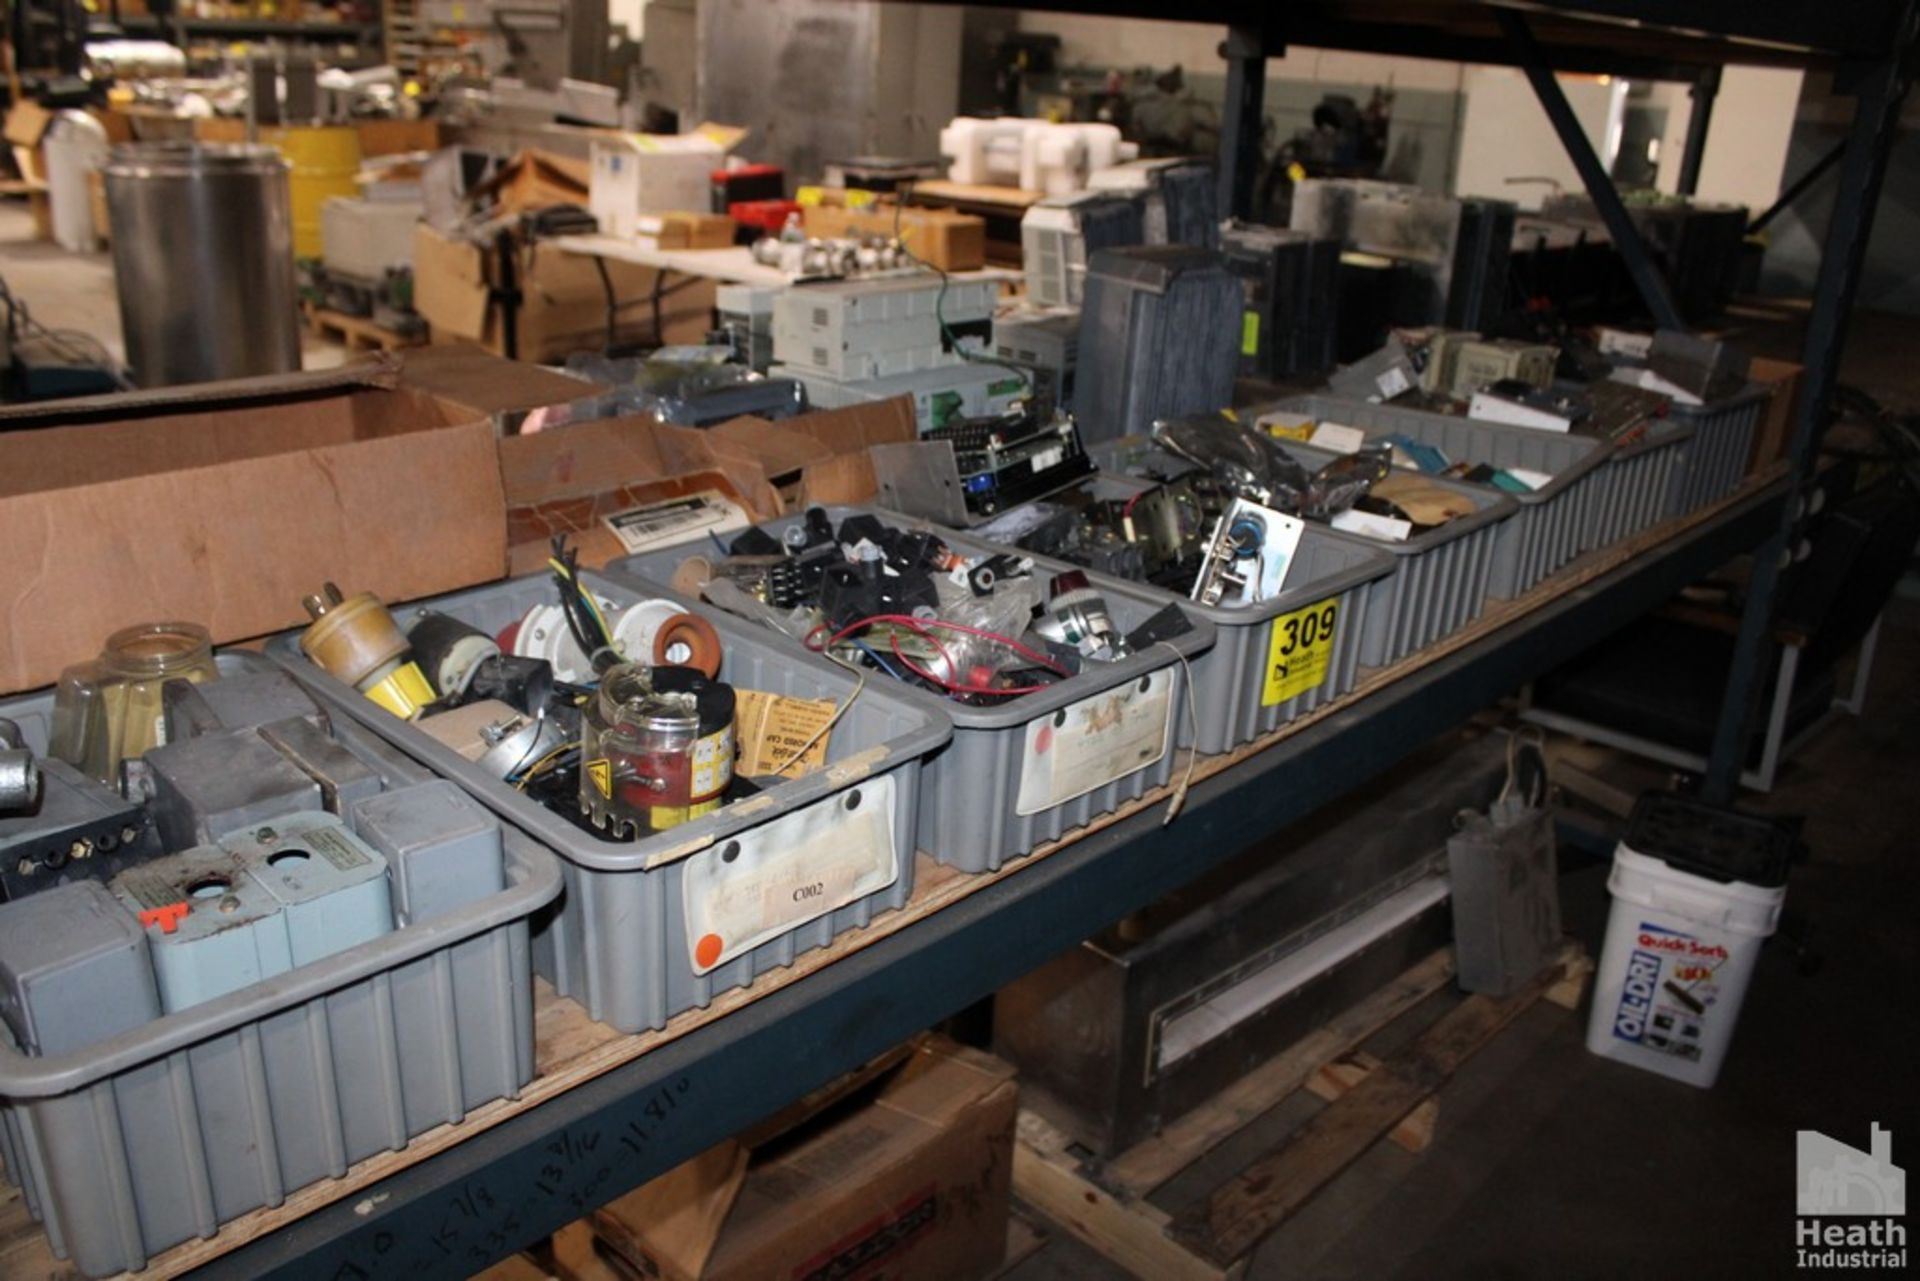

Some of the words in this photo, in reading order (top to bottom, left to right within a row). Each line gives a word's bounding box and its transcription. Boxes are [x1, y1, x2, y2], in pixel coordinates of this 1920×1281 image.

[1281, 605, 1336, 655] 309
[793, 883, 824, 903] C002
[1638, 933, 1686, 951] Quick
[1690, 940, 1729, 959] Sorb
